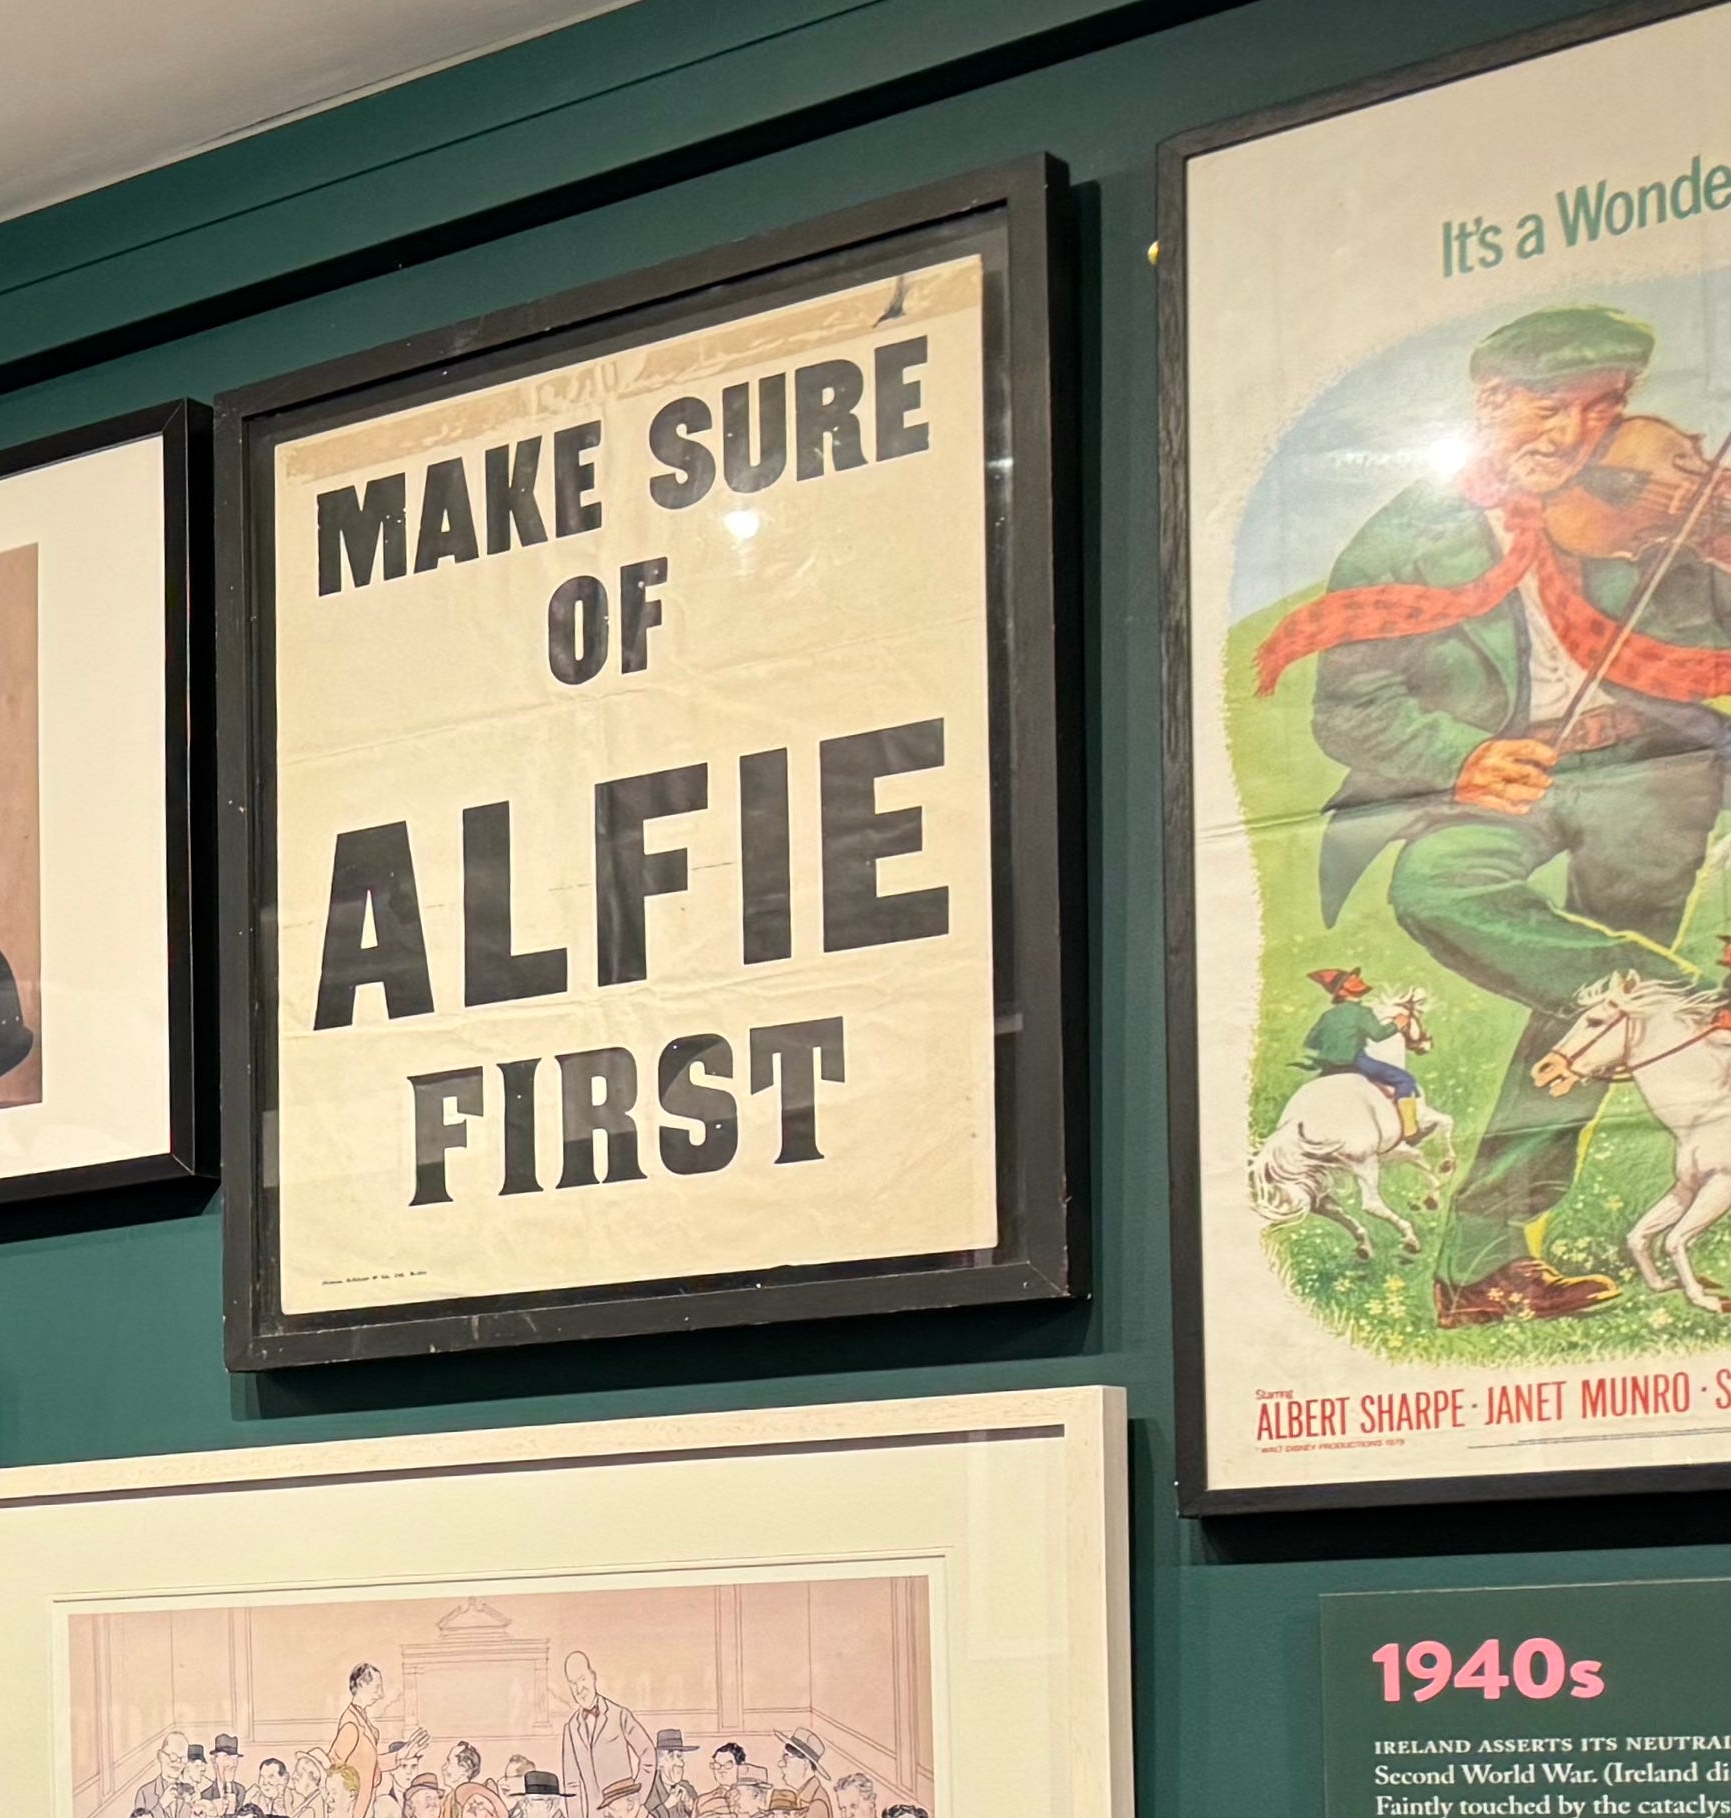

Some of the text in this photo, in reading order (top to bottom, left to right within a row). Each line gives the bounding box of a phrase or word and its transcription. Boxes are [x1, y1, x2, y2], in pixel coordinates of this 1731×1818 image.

[1442, 216, 1503, 278] It's
[1516, 213, 1545, 260] a
[316, 336, 931, 597] MAKE SURE
[546, 556, 668, 687] OF
[313, 716, 951, 1032] ALFIE
[407, 1015, 846, 1208] FIRST
[1256, 1371, 1691, 1441] ALBERT SHARPE JANET MUNRO
[1371, 1636, 1606, 1703] 1940s
[1374, 1737, 1617, 1754] IRELAND ASSERTS ITS
[1374, 1761, 1698, 1785] Second World War. (Ireland
[1459, 1794, 1550, 1814] touched
[1592, 1794, 1630, 1814] the
